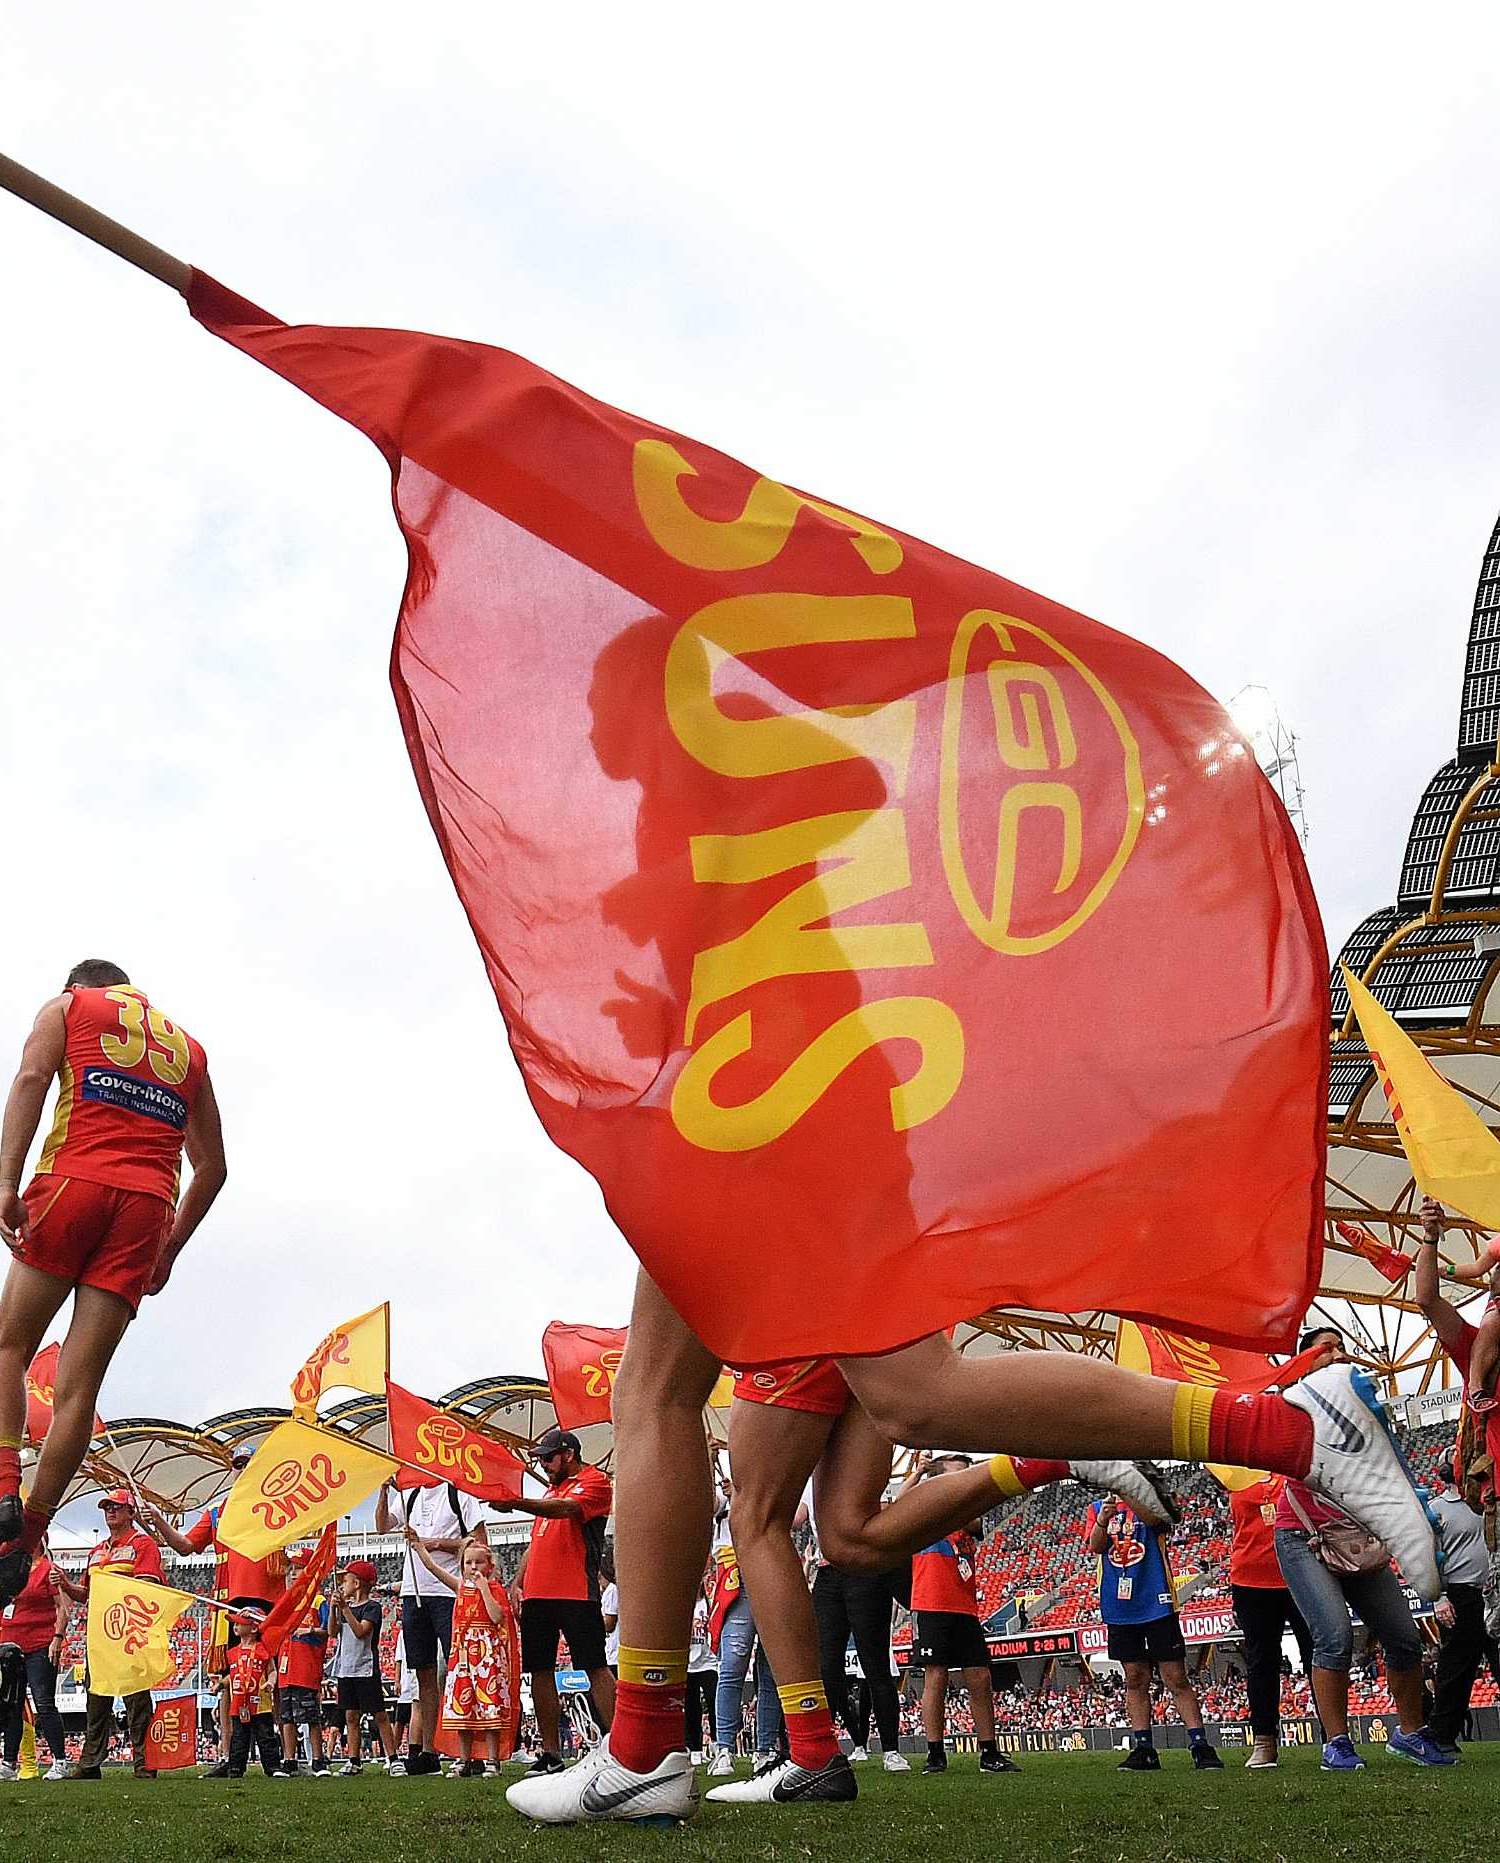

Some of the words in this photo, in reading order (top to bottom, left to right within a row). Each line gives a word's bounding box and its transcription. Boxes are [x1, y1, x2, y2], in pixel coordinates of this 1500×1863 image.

[632, 439, 964, 1152] SUNS
[100, 991, 190, 1085] 39
[87, 1071, 186, 1117] Cover-More
[98, 1090, 129, 1106] TRAVEL
[1420, 1391, 1462, 1410] STADIUM
[1033, 1639, 1055, 1653] 2:26
[1058, 1637, 1070, 1650] PM
[996, 1735, 1020, 1752] OUR
